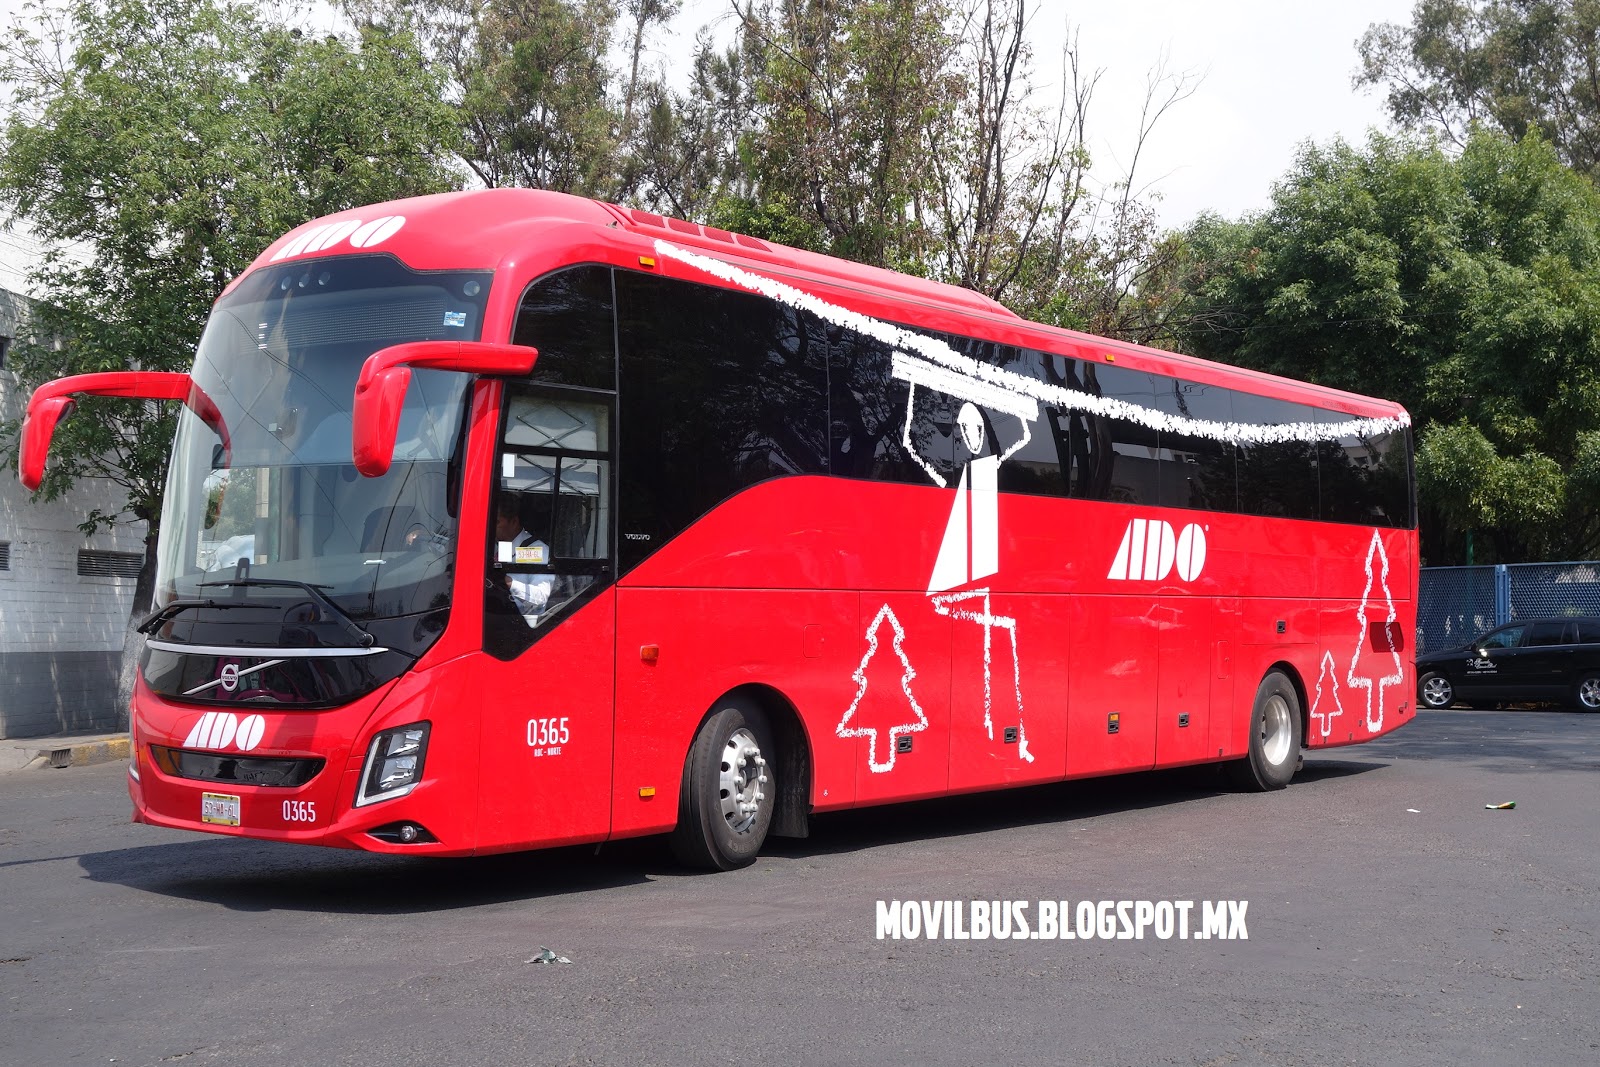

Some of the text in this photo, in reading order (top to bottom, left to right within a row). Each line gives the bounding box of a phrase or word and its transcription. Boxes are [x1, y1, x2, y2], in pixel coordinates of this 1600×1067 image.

[269, 215, 406, 262] ADO
[1107, 518, 1207, 582] ADO
[183, 712, 265, 751] ADO
[527, 717, 569, 746] 0365
[282, 800, 316, 822] 0365
